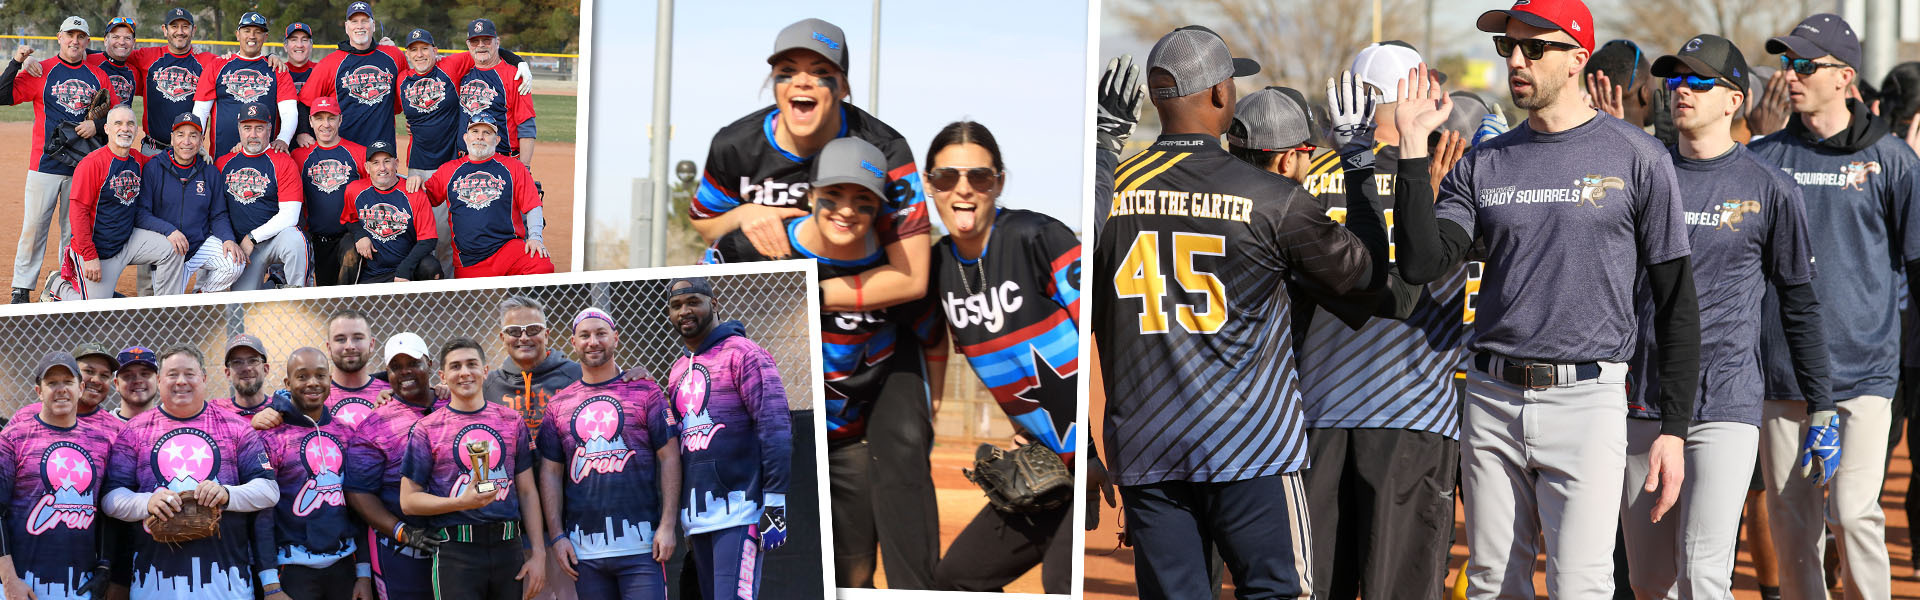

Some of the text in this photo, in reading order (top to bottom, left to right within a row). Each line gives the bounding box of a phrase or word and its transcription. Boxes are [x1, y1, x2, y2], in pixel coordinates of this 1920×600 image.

[111, 80, 134, 95] PACT
[221, 74, 273, 87] IMPACT
[341, 72, 393, 88] IMPACT
[404, 81, 446, 98] IMPACT
[460, 85, 499, 101] MPACT
[308, 164, 352, 177] IMPACT
[225, 173, 271, 189] IMPACT
[452, 178, 506, 192] IMPACT
[1320, 172, 1346, 194] CAT
[1374, 173, 1392, 196] HE
[1794, 172, 1847, 187] SQUIRRELS
[1480, 189, 1580, 208] SHADY SQUIRRELS
[1111, 190, 1253, 224] CATCH THE GARTER
[359, 208, 411, 224] IMPACT
[1683, 211, 1721, 227] IRRELS
[1113, 231, 1229, 335] 45
[942, 280, 1024, 333] tsyc
[185, 428, 218, 450] TENNESSEE
[737, 538, 758, 600] CREW
